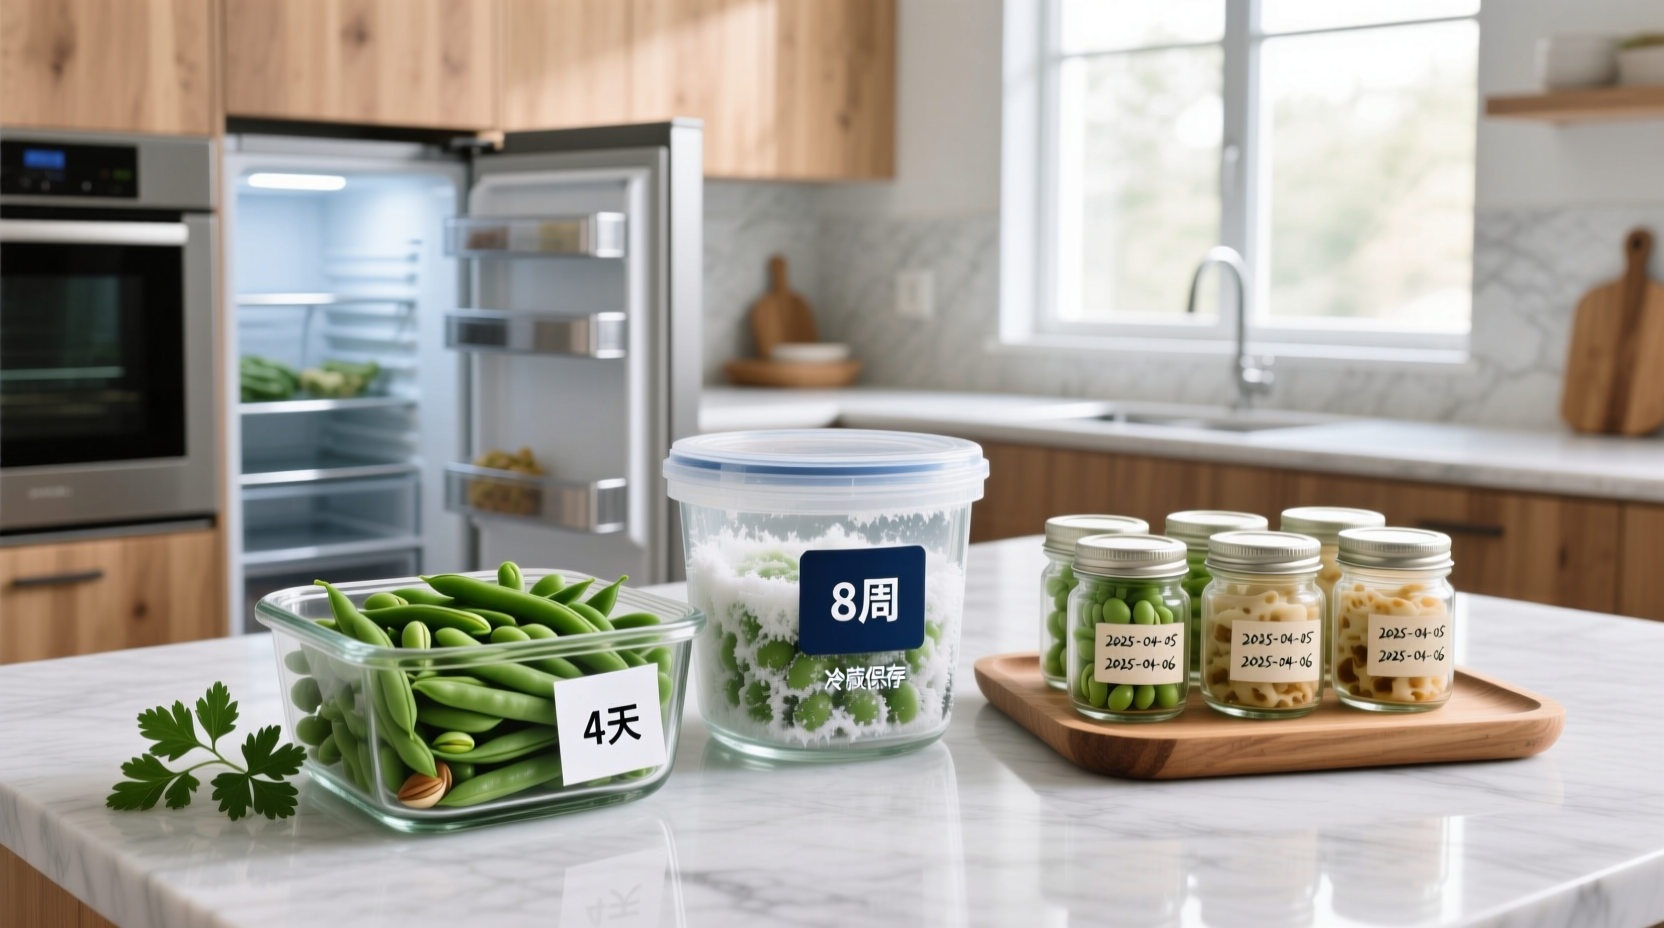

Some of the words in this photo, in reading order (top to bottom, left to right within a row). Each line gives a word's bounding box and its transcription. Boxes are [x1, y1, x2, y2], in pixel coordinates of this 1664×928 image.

[831, 577, 899, 625] 8周
[1105, 633, 1178, 648] 2025-04-05
[1241, 630, 1315, 647] 2025-04-05
[1378, 624, 1446, 640] 2025-04-05
[1241, 653, 1313, 670] 2025-04-06
[1378, 646, 1445, 663] 2025-04-06
[1104, 655, 1176, 672] 2025-04-06
[583, 703, 642, 746] 4天
